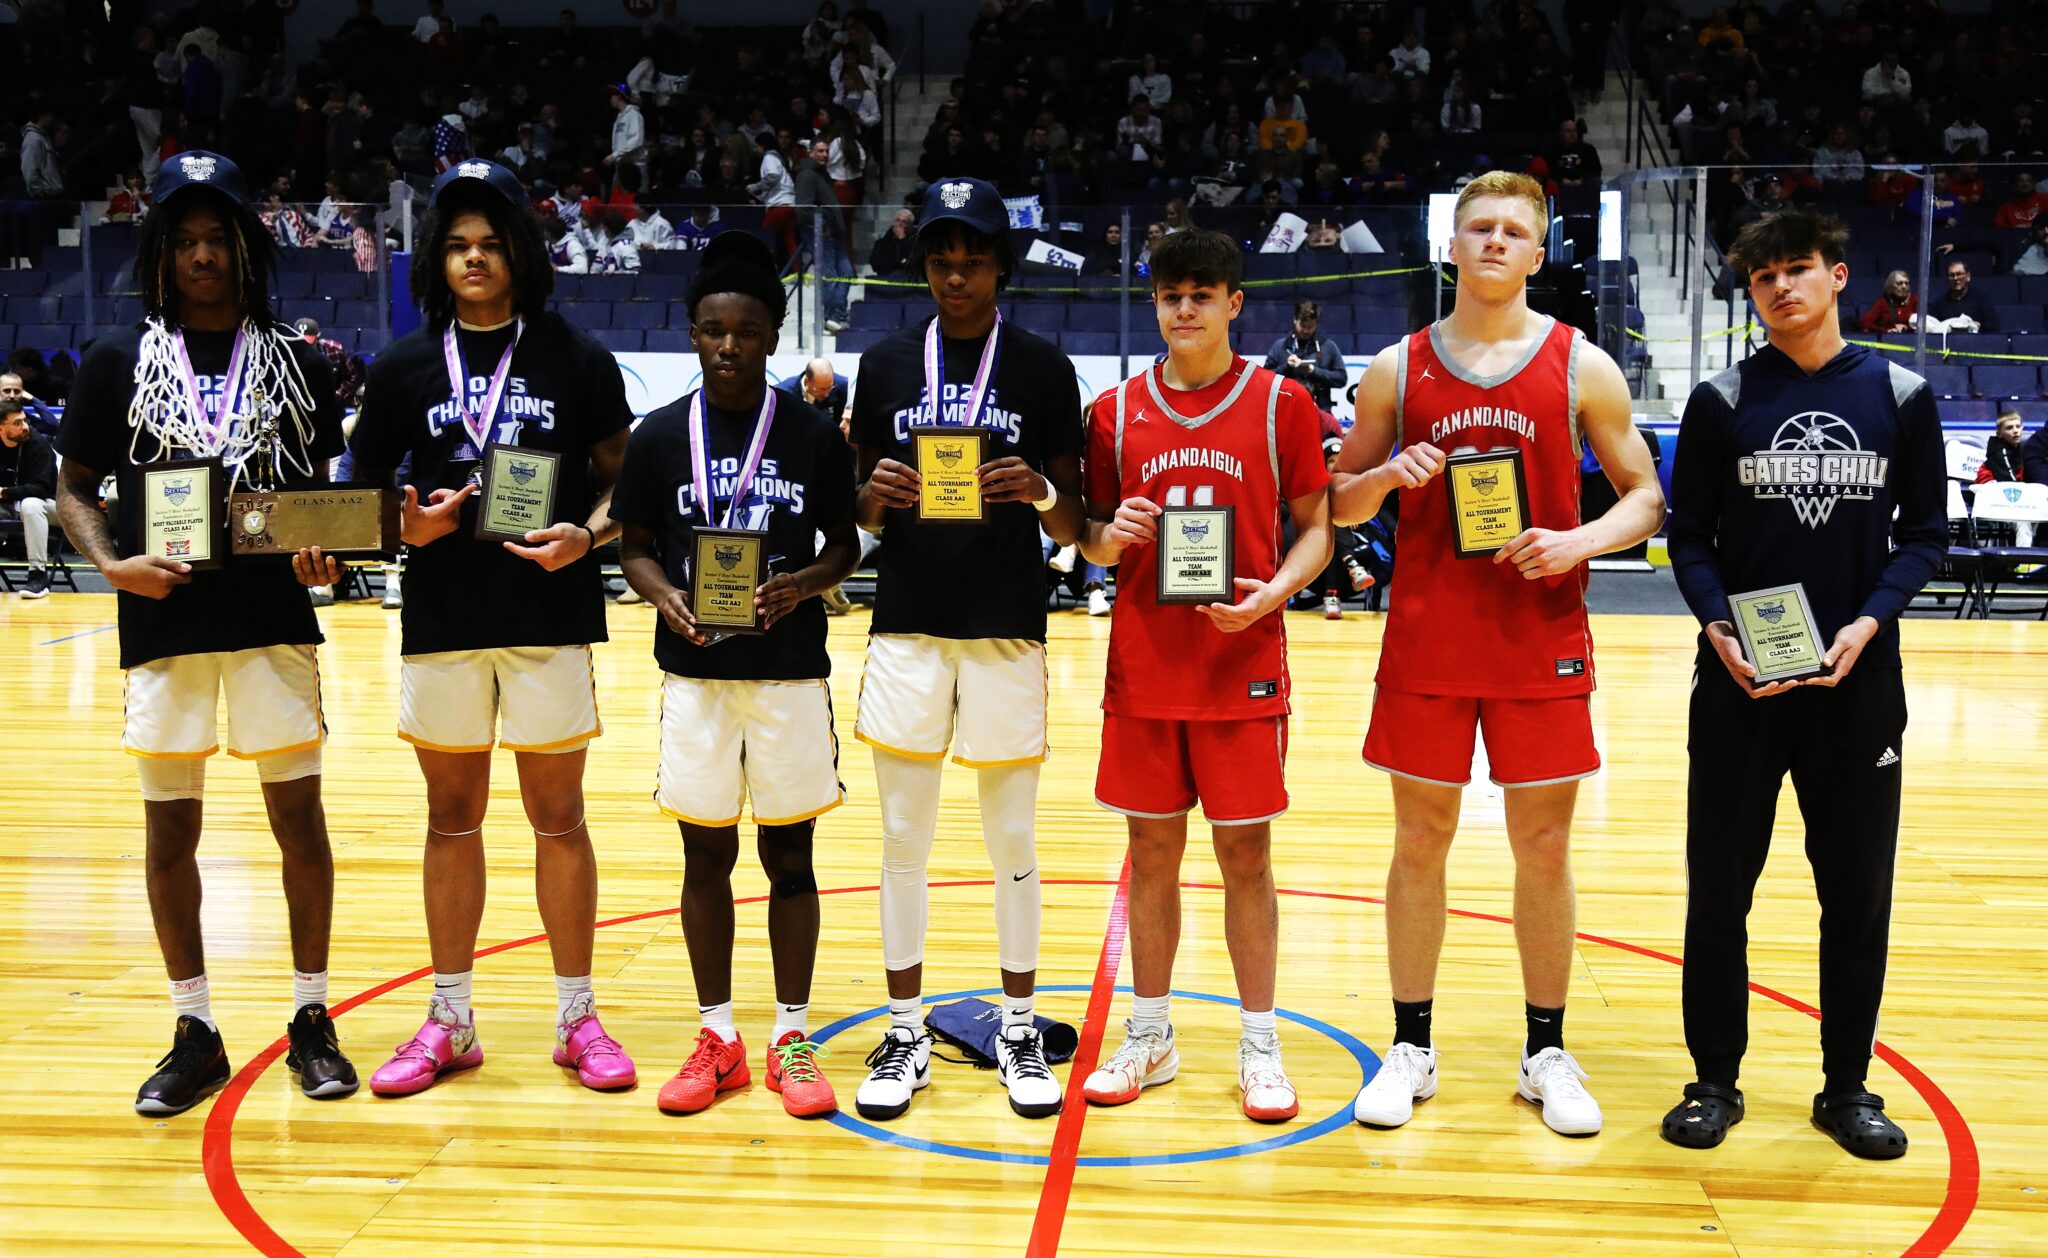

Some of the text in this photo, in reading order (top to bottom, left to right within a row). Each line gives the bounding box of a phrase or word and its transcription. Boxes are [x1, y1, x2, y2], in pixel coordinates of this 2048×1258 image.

[942, 190, 970, 198] SECTION
[1431, 406, 1536, 444] CANANDAIGUA
[1142, 448, 1243, 484] CANANDAIGUA
[1738, 455, 1820, 486] GATES
[1754, 486, 1874, 496] BASKETBALL
[338, 497, 363, 505] AA2
[507, 496, 542, 506] TOURNAMENT
[1476, 507, 1512, 516] TOURNAMENT
[1768, 632, 1804, 643] TOURNAMENT
